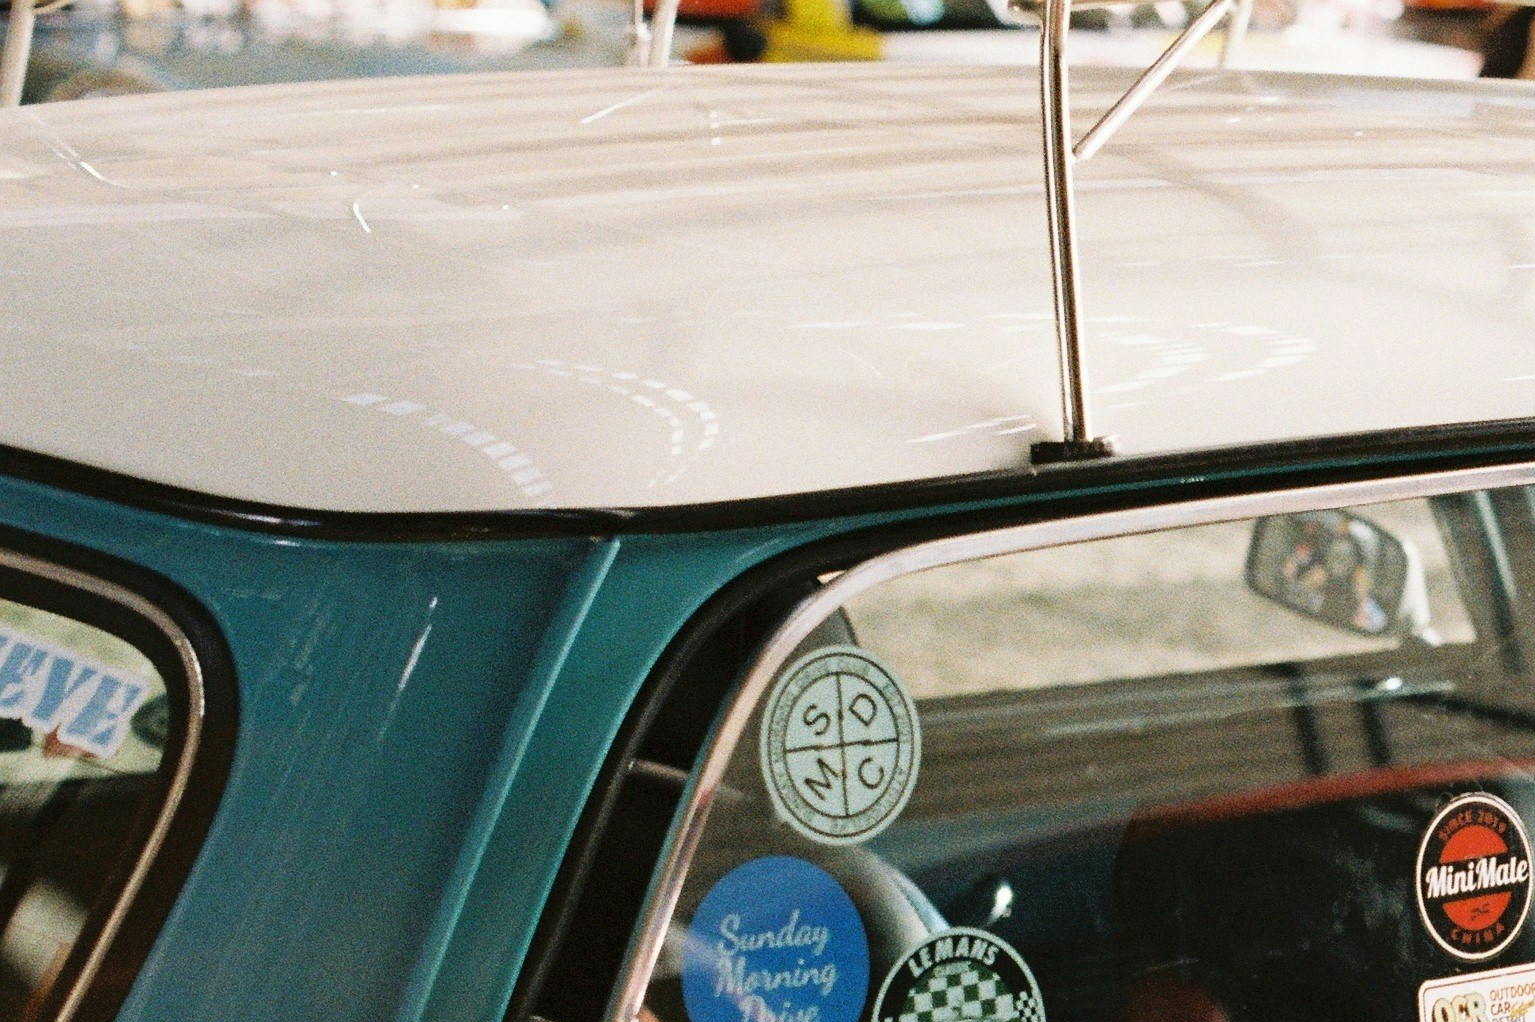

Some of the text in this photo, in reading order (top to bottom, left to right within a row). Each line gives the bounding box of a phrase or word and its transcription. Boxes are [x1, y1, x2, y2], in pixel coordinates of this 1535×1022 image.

[716, 908, 830, 956] Sunday
[713, 955, 837, 998] Morning
[1490, 1002, 1511, 1016] CAR
